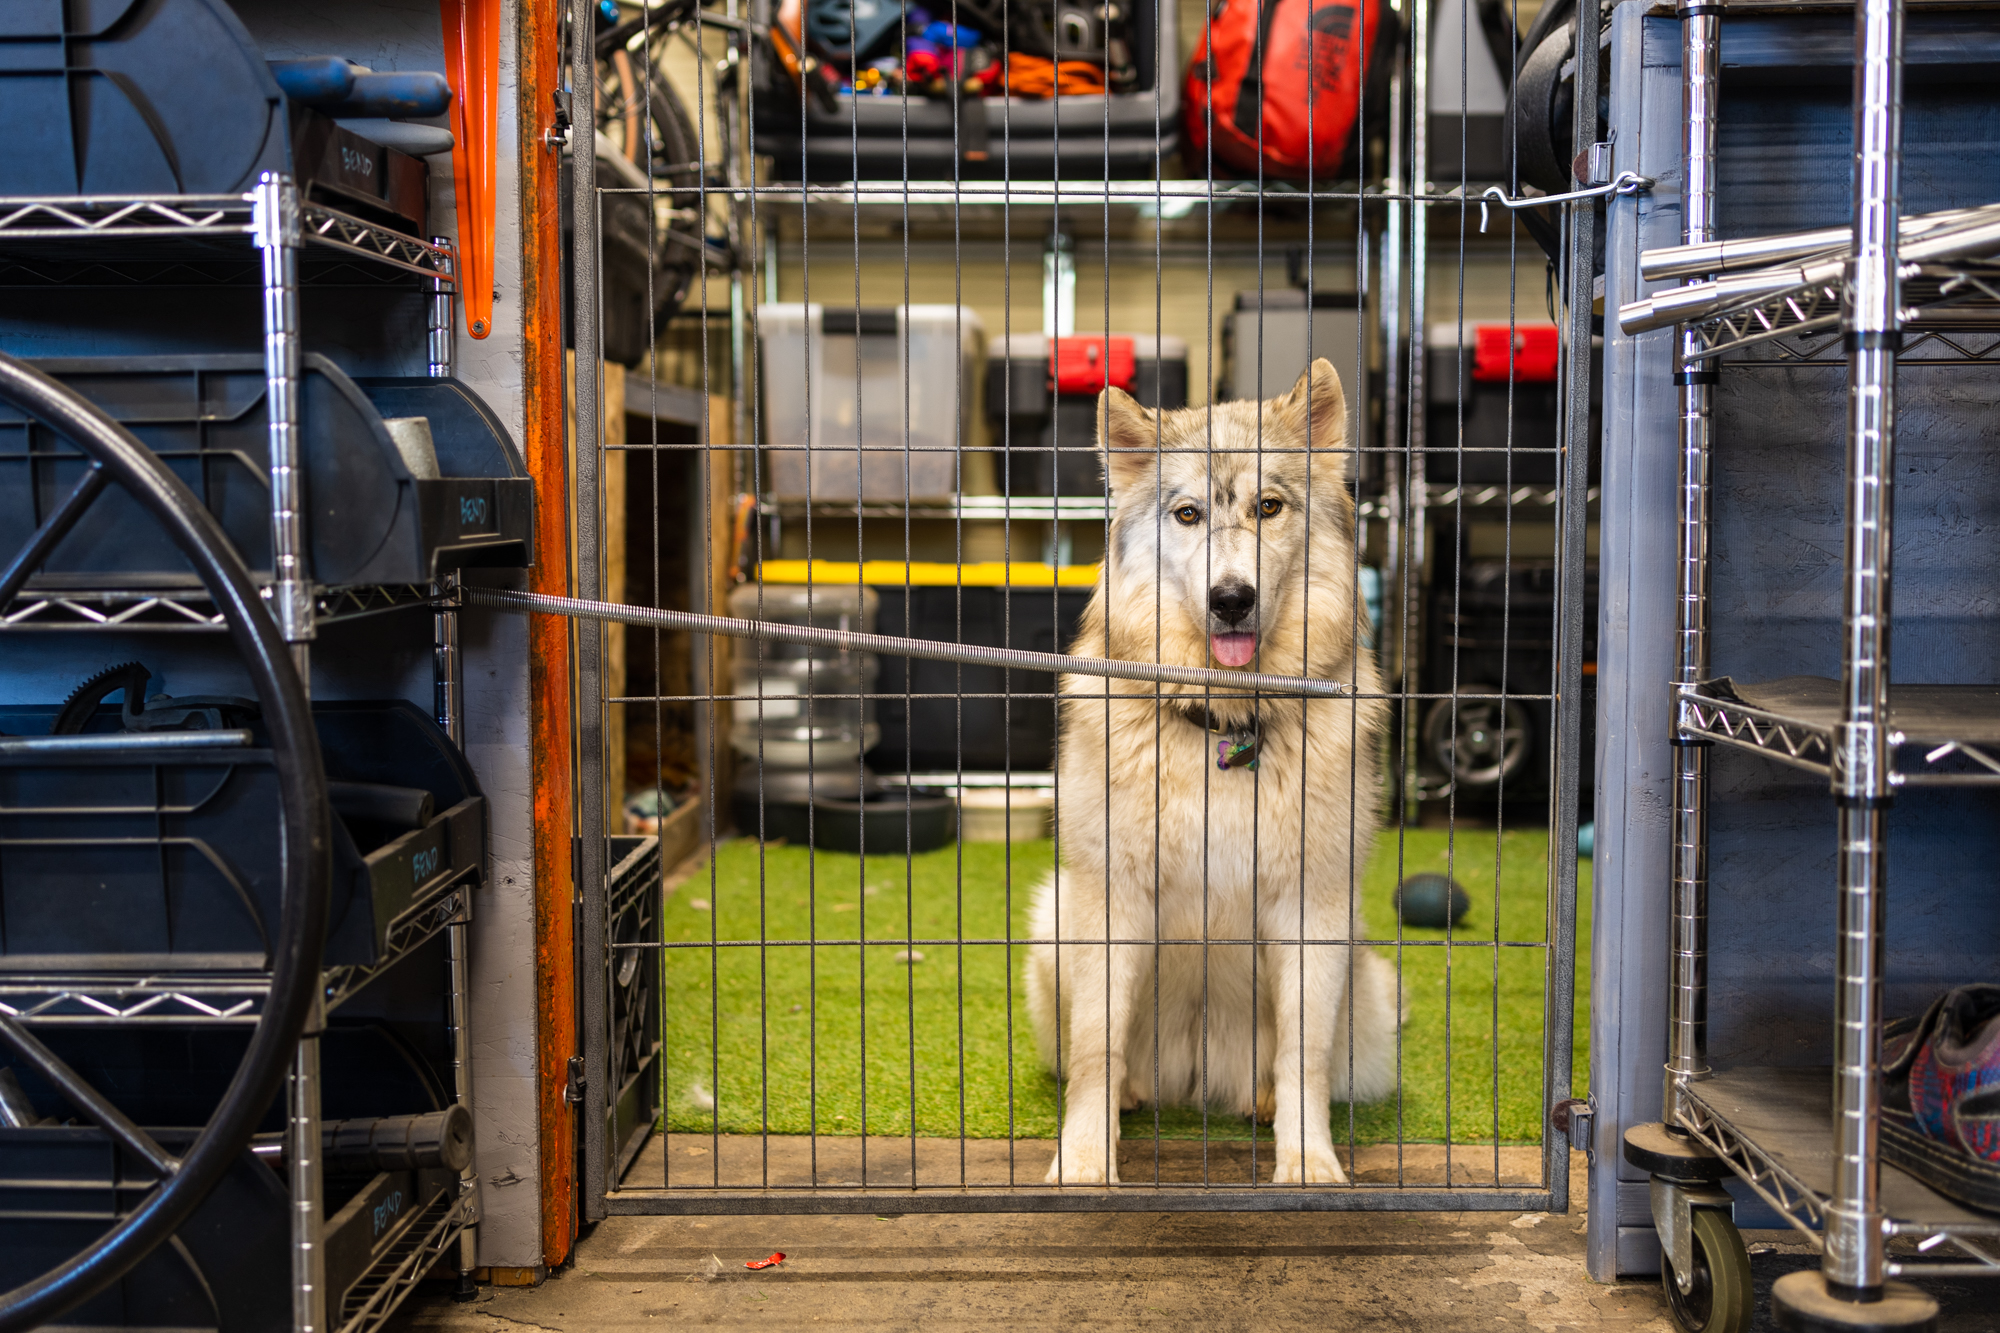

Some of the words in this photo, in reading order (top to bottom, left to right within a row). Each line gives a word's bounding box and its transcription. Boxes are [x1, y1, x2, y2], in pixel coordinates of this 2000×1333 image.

[342, 147, 373, 177] BEND
[460, 496, 487, 525] BEND
[413, 846, 438, 884] BEND
[374, 1190, 402, 1236] BEND
